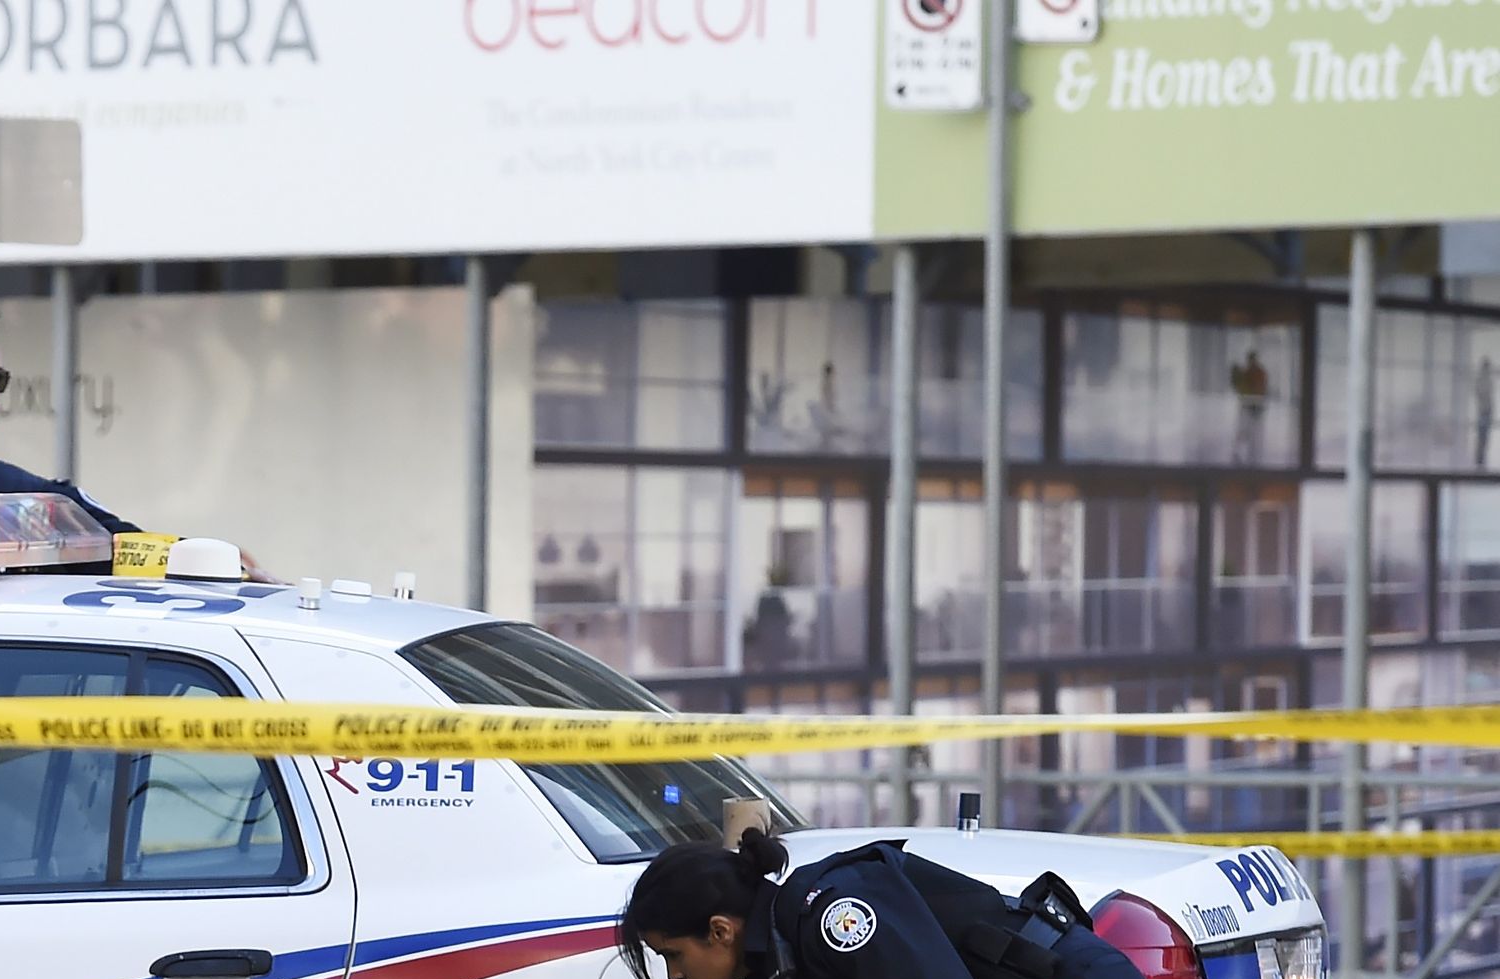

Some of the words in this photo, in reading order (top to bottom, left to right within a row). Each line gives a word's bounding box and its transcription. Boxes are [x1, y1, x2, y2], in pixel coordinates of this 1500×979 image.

[1054, 50, 1097, 112] &
[1109, 47, 1276, 110] Homes
[1290, 39, 1408, 102] That
[1410, 33, 1500, 98] Are
[38, 717, 109, 740] POLICE
[119, 716, 174, 740] LINE-
[180, 719, 205, 738] DO
[211, 718, 245, 739] NOT
[252, 717, 310, 738] CROSS
[335, 713, 408, 736] POLICE
[366, 757, 476, 793] 9-1-1
[371, 797, 475, 808] EMERGENCY
[1193, 903, 1241, 938] TORONTO
